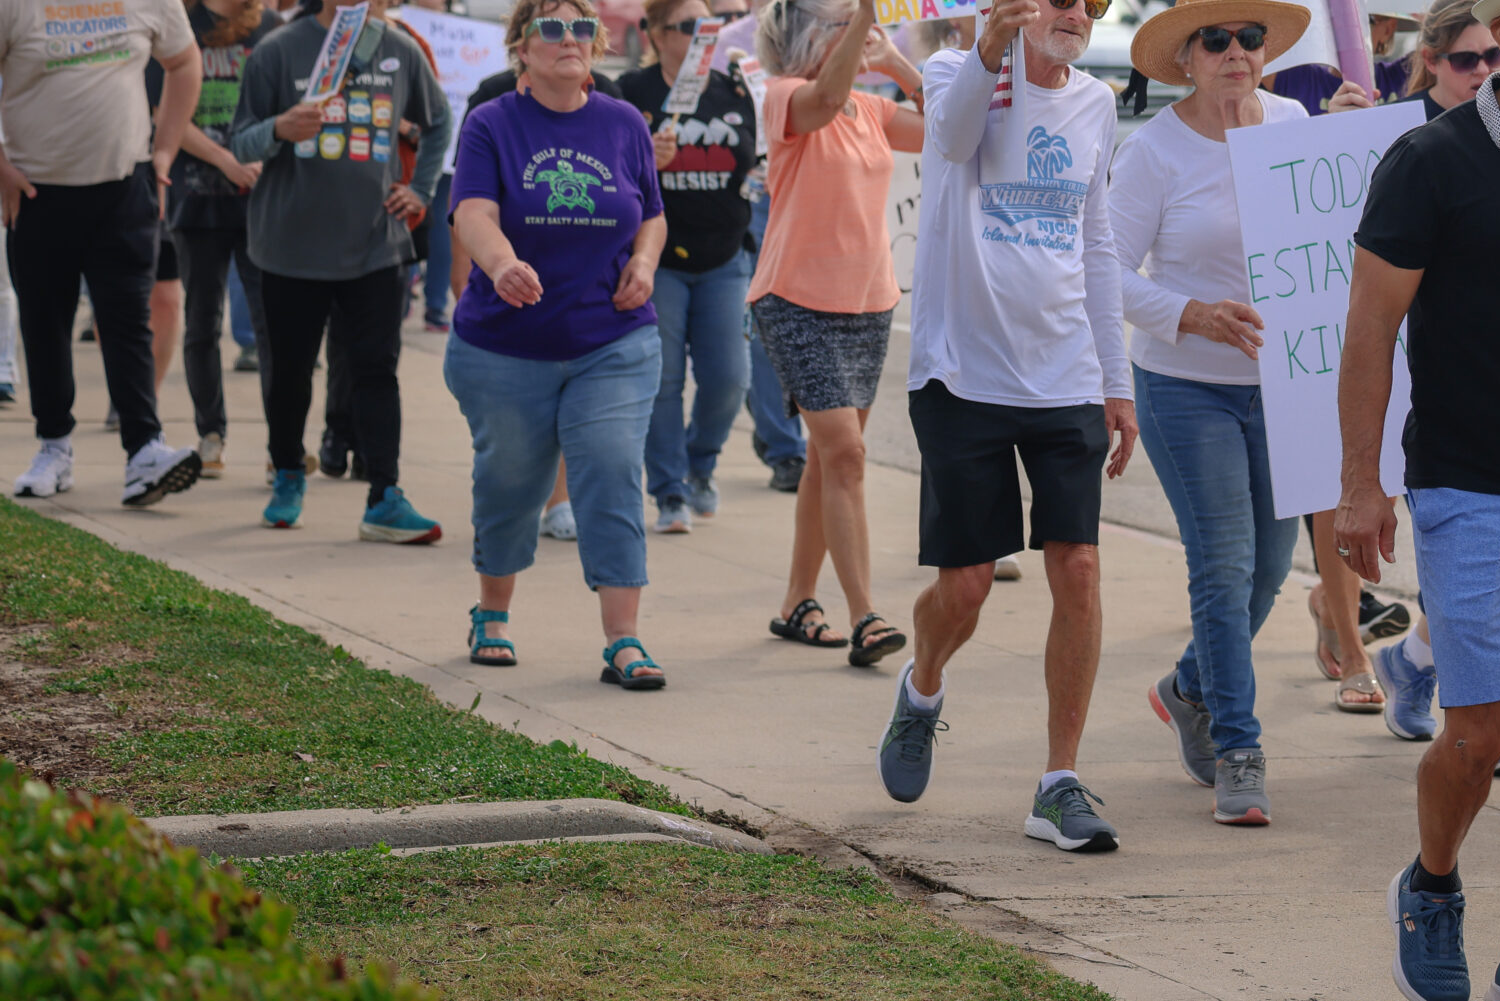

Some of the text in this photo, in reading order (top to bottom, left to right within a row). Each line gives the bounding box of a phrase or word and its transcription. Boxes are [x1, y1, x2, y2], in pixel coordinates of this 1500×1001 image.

[45, 1, 124, 20] SCIENCE
[46, 16, 127, 36] EDUCATORS
[523, 148, 613, 181] THE GULF OF MEXICO
[662, 171, 732, 190] RESIST
[525, 217, 617, 227] STAY SALTY AND RESIST
[982, 226, 1022, 246] Island
